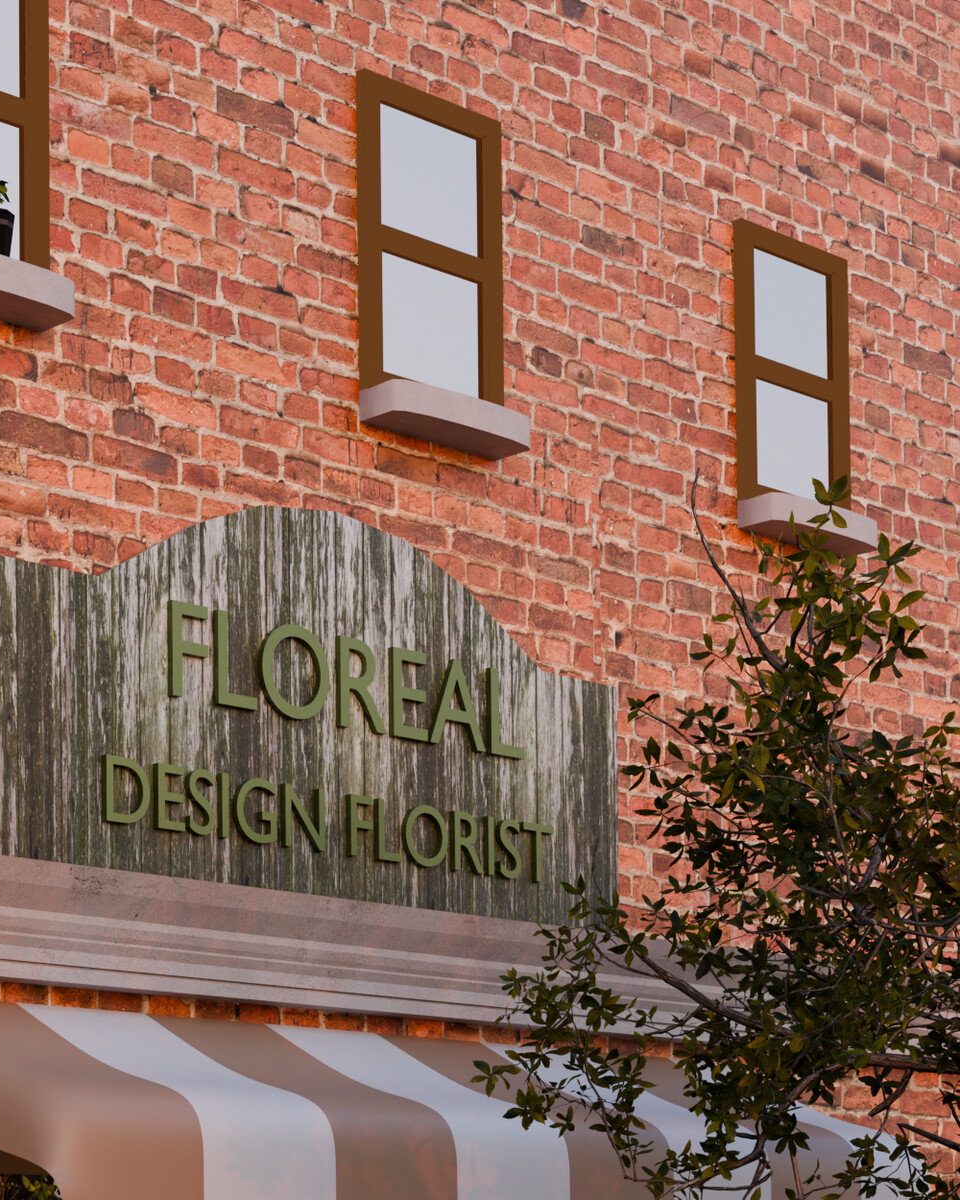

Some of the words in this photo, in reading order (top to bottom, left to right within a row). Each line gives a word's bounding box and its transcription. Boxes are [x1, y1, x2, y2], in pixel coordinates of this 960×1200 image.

[167, 599, 526, 760] FLOREAL
[102, 754, 326, 853] DESIGN
[347, 793, 554, 883] FLORIST
